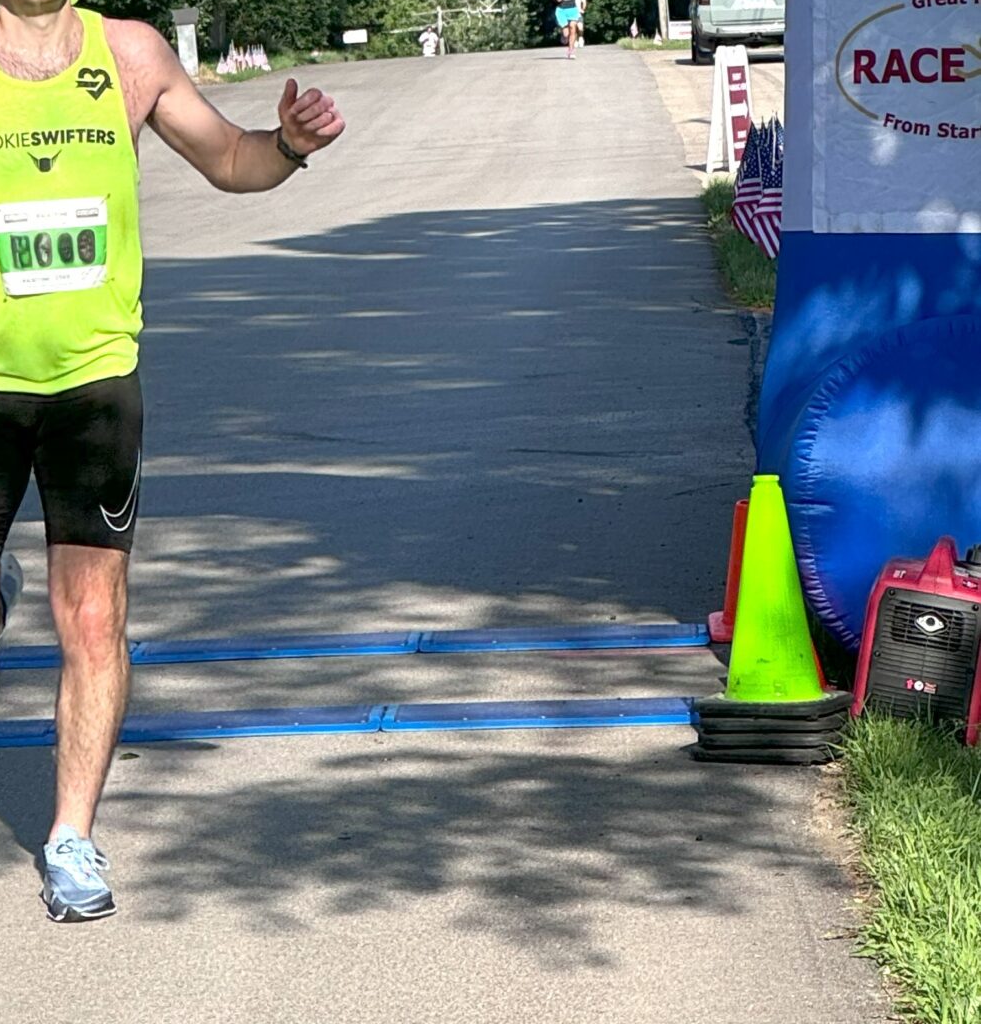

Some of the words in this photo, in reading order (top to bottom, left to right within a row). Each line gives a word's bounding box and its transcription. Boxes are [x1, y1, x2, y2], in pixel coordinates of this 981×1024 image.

[853, 47, 966, 85] RACE
[883, 112, 931, 136] From
[937, 122, 981, 139] Star
